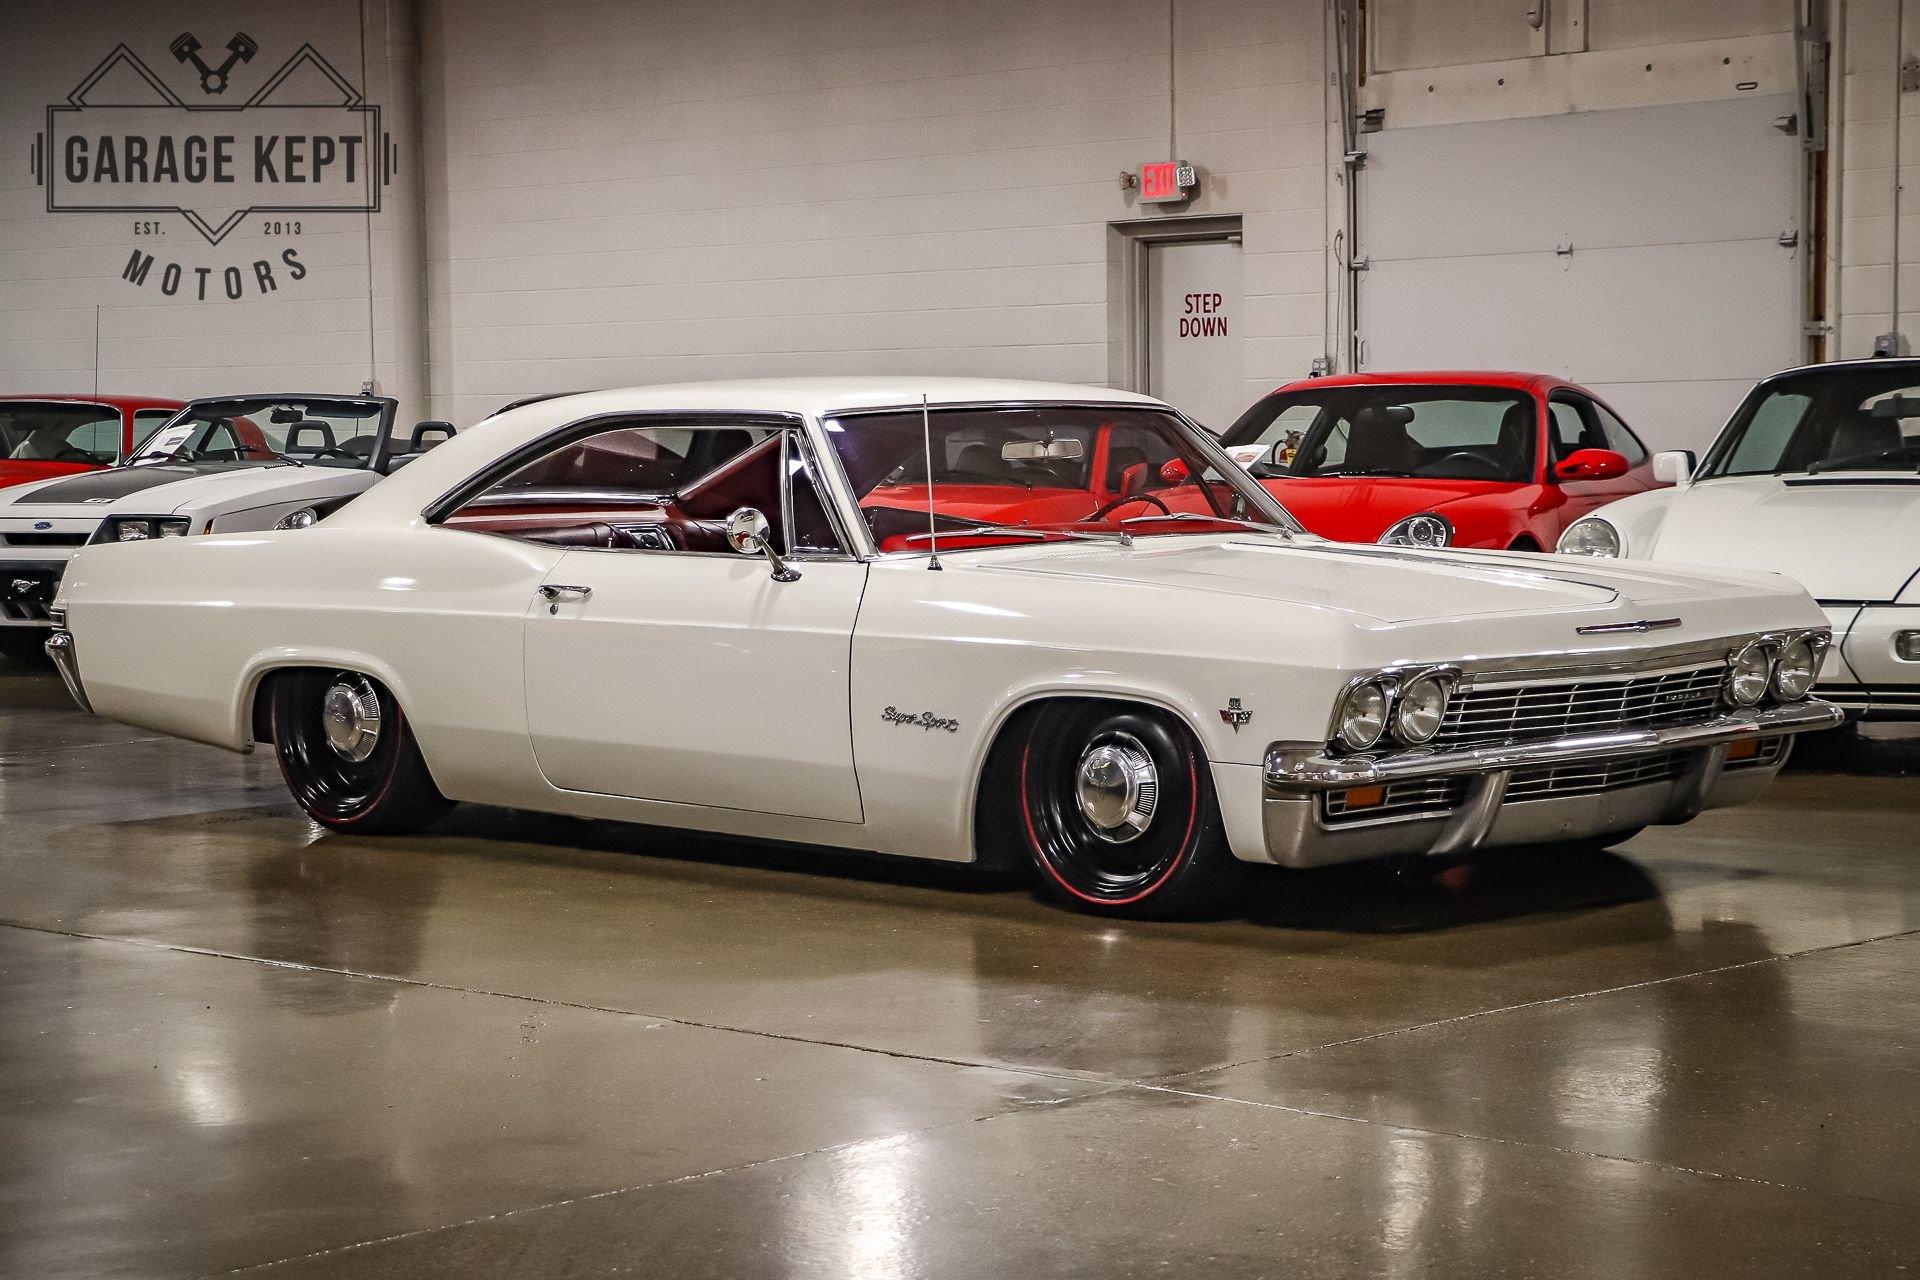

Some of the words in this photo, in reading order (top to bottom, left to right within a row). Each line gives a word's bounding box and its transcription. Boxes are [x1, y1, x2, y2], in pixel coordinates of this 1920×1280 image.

[1144, 164, 1175, 197] EXIT
[1184, 293, 1222, 315] STEP
[1179, 317, 1228, 338] DOWN
[880, 705, 918, 727] Super
[921, 711, 959, 733] Sport
